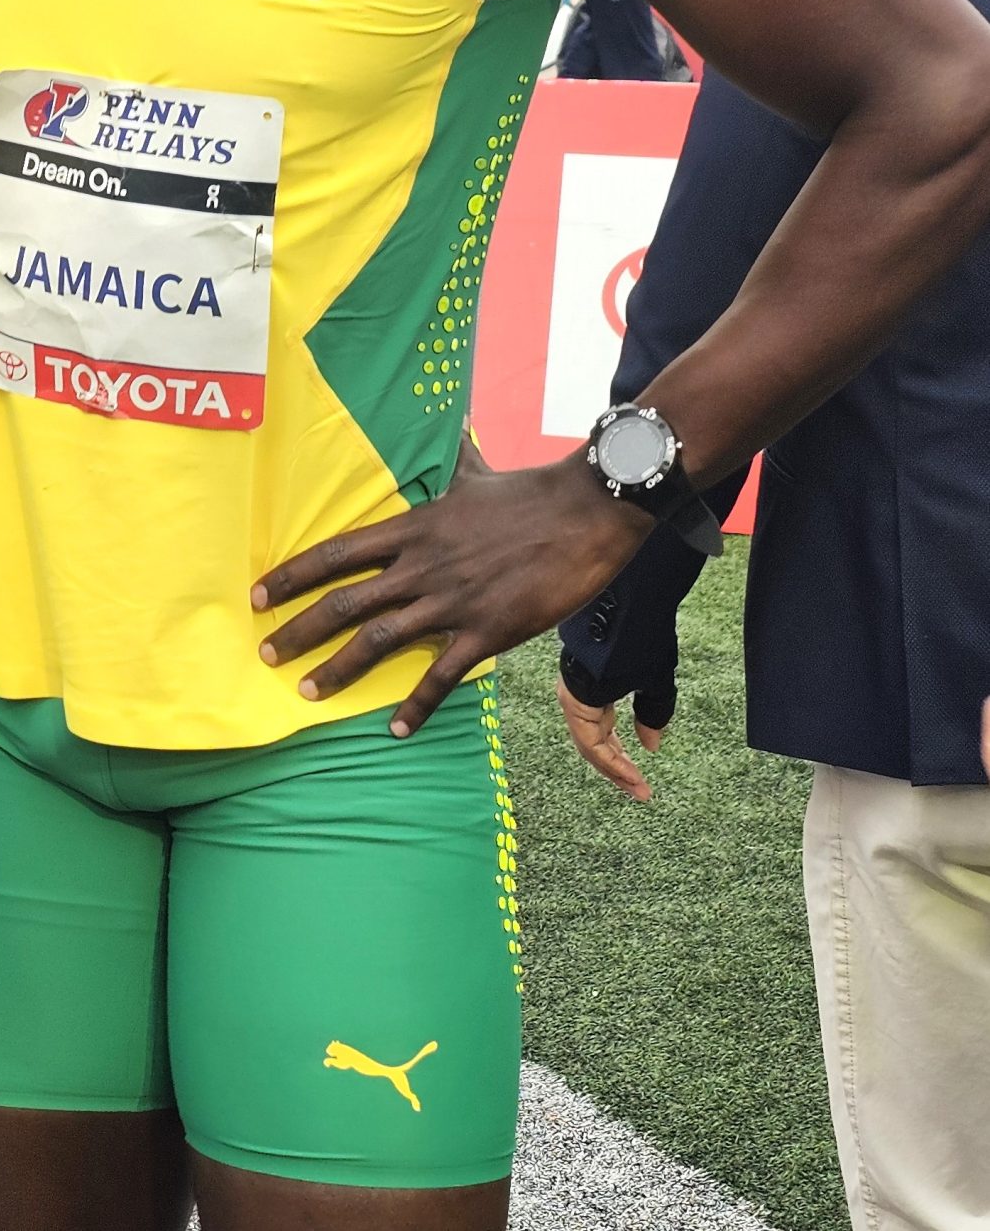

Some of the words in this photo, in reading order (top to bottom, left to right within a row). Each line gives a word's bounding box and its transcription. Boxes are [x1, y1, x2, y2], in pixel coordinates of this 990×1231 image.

[101, 92, 207, 129] PENN
[91, 122, 237, 165] RELAYS
[22, 152, 85, 189] Dream
[88, 172, 128, 198] On.
[4, 245, 223, 318] JAMAICA
[44, 356, 232, 419] TOYOTA
